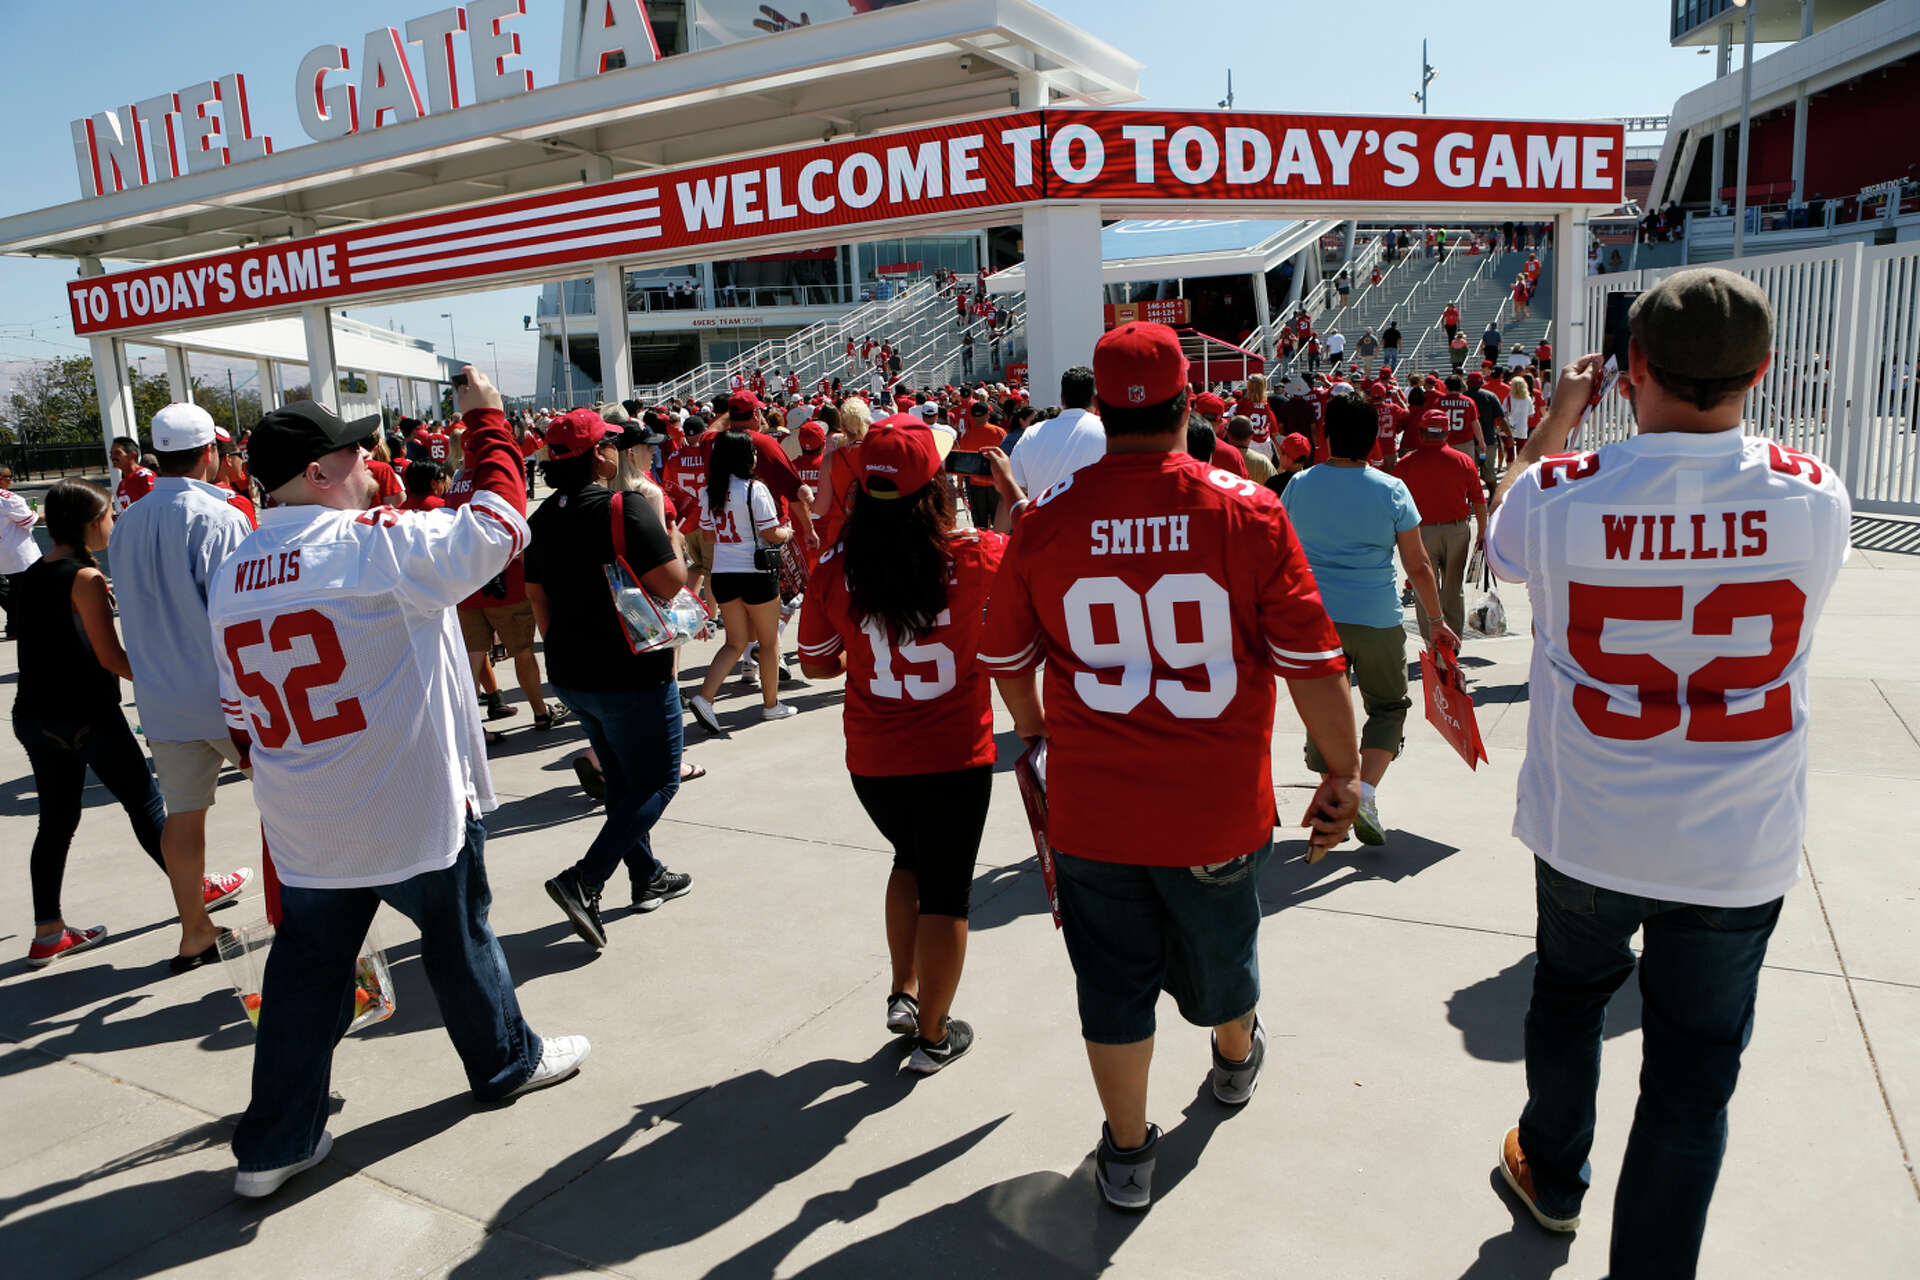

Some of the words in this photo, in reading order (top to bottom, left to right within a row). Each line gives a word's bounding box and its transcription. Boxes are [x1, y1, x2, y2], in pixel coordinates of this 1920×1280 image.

[71, 72, 272, 199] INTEL
[296, 0, 533, 141] GATE
[577, 0, 662, 78] A
[676, 133, 987, 233] WELCOME
[1002, 123, 1105, 187] TO
[1122, 126, 1421, 187] TODAY'S
[1433, 132, 1614, 190] GAME
[73, 286, 110, 324] TO
[112, 262, 237, 319] TODAY'S
[240, 244, 341, 295] GAME
[1250, 412, 1268, 435] 21
[1446, 408, 1465, 431] 15
[431, 445, 446, 459] 85
[681, 456, 705, 467] WILL
[715, 510, 743, 543] 21
[1091, 515, 1190, 555] SMITH
[1602, 510, 1767, 560] WILLIS
[235, 549, 302, 594] WILLIS
[861, 607, 957, 700] 15
[1063, 572, 1238, 720] 99
[1568, 579, 1807, 743] 52
[223, 609, 367, 748] 52
